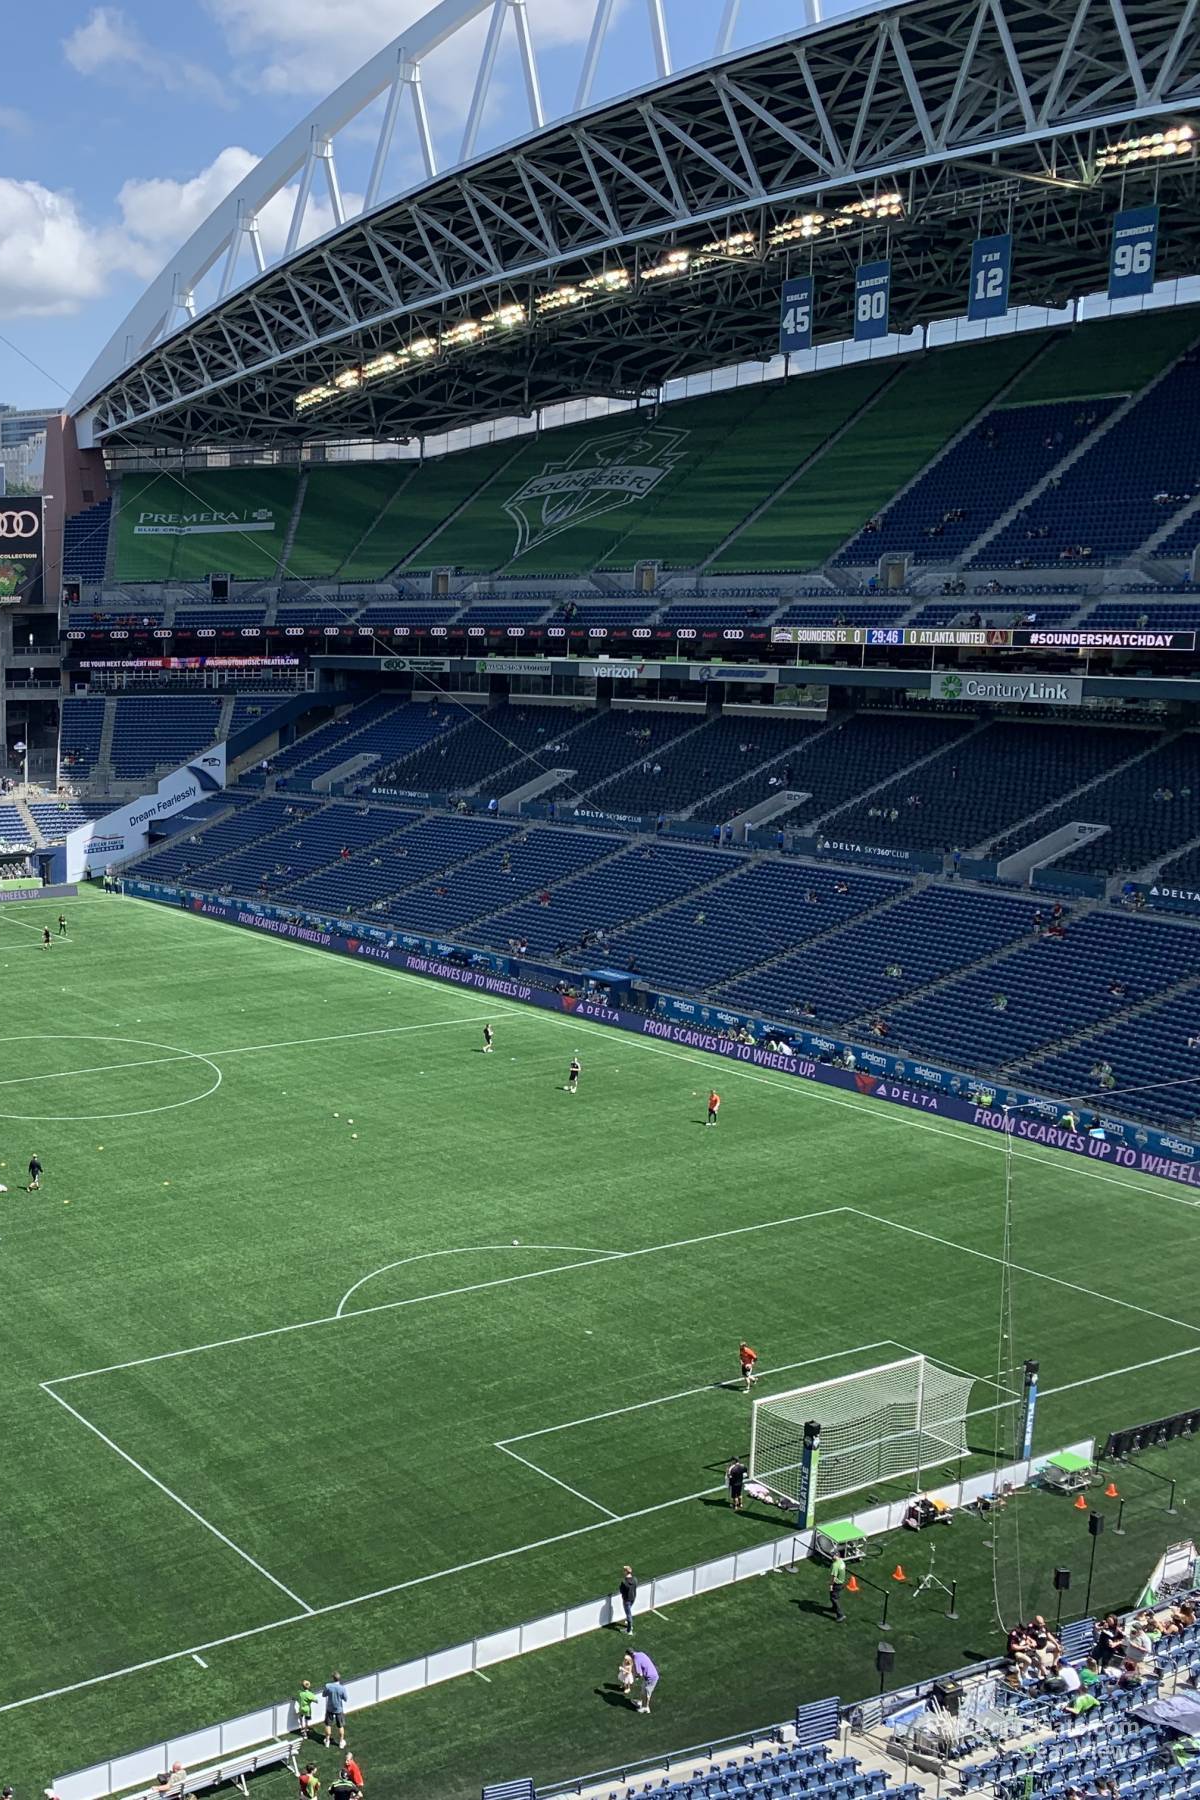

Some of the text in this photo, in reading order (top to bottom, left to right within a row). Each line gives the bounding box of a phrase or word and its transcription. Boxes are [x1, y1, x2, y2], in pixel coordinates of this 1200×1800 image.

[982, 252, 1001, 263] FAN
[1114, 241, 1152, 277] 96
[975, 267, 1003, 300] 12
[858, 291, 886, 322] 80
[782, 305, 810, 335] 45
[521, 475, 652, 498] SOUNDERS FC
[138, 511, 240, 524] PREMERA
[797, 630, 861, 643] SOUNDERS FC 0
[871, 631, 899, 644] 29:46
[910, 631, 985, 645] 0 ATLANTA UNITED
[1029, 633, 1174, 647] #SOUNDERSMATCHDAY
[592, 665, 638, 679] verizon
[966, 680, 1069, 701] CenturyLink
[129, 786, 197, 827] Dream Fearlessly
[580, 810, 604, 819] DELTA
[833, 842, 861, 852] DELTA
[28, 890, 41, 899] UP.
[1162, 888, 1200, 902] DELTA
[208, 905, 226, 915] DELTA
[238, 912, 331, 946] FROM SCARVES UP TO WHEELS UP.
[366, 946, 390, 959] DELTA
[406, 956, 531, 1000] FROM SCARVES UP TO WHEELS UP.
[587, 1006, 620, 1022] DELTA
[672, 1001, 695, 1011] slalom
[716, 1011, 739, 1023] slalom
[643, 1019, 816, 1078] FROM SCARVES UP TO WHEELS UP.
[811, 1036, 836, 1050] slalom
[861, 1051, 887, 1066] slalom
[914, 1065, 942, 1082] slalom
[968, 1080, 997, 1096] slalom
[891, 1088, 938, 1110] DELTA
[1028, 1097, 1058, 1116] slalom
[974, 1108, 1015, 1133] FROM
[1018, 1120, 1086, 1152] SCARVES
[1088, 1139, 1111, 1158] UP
[1116, 1146, 1136, 1166] TO
[1160, 1137, 1195, 1155] slalom
[800, 1466, 810, 1513] SEATTLE
